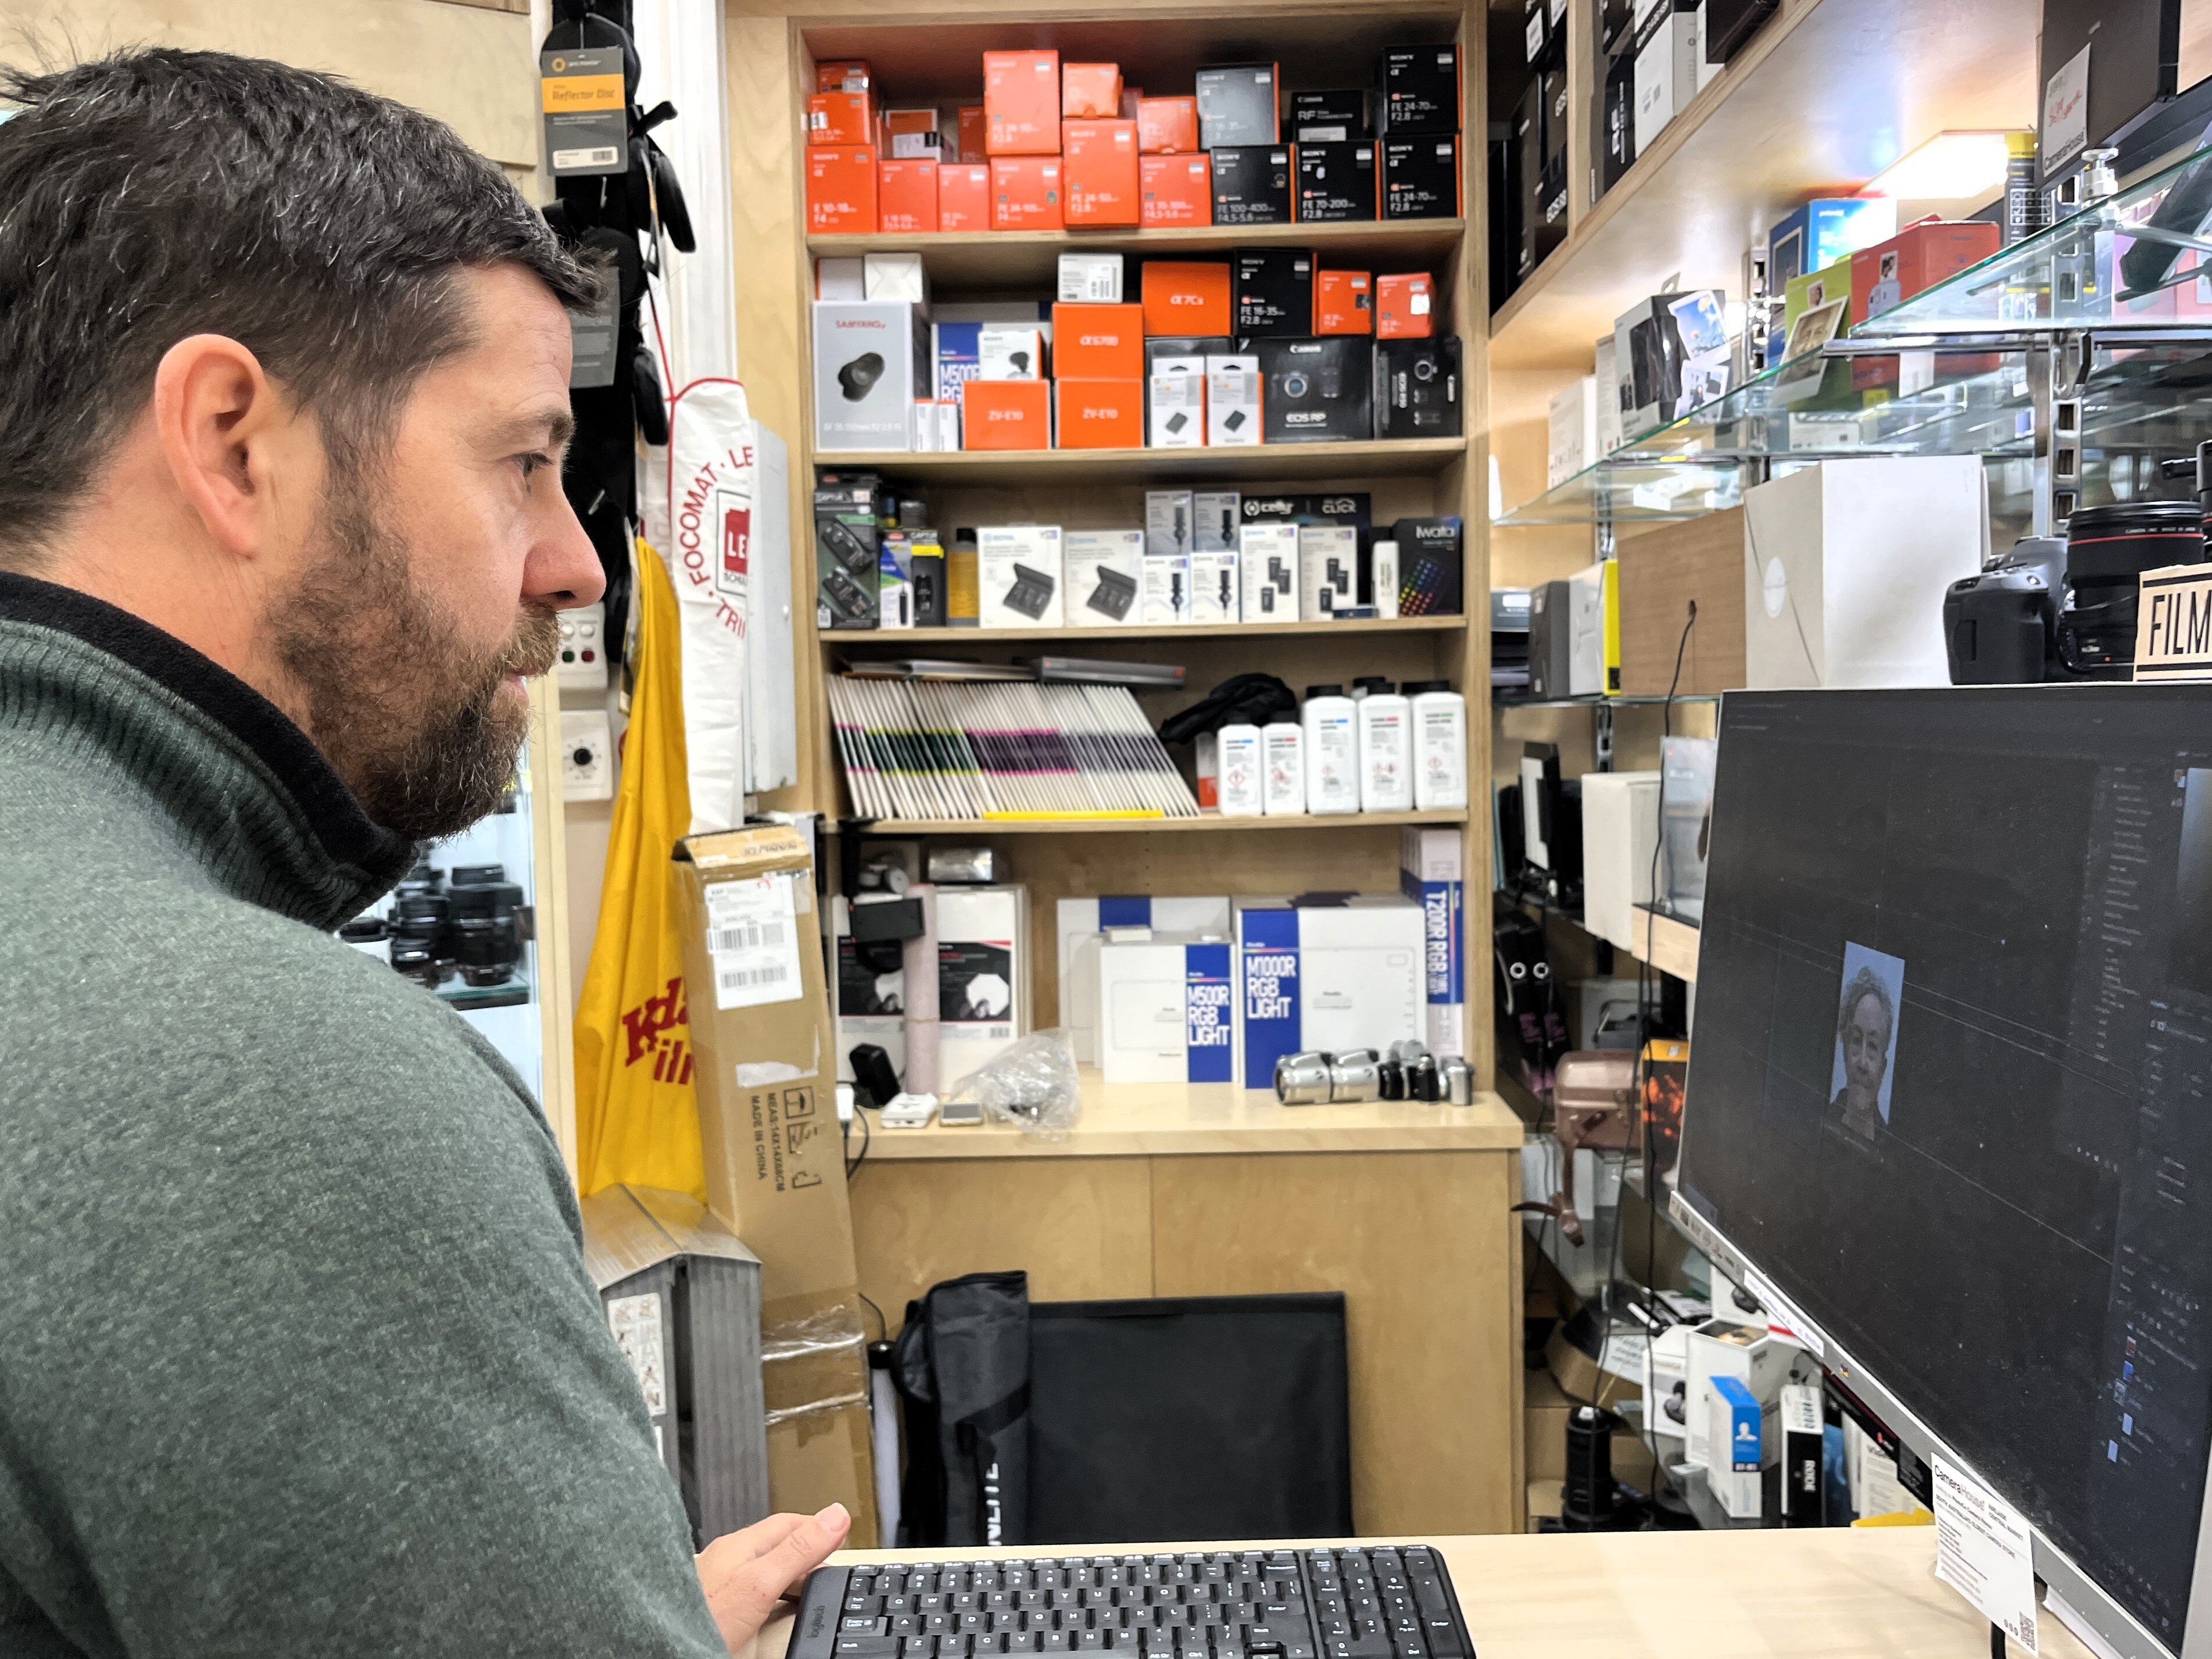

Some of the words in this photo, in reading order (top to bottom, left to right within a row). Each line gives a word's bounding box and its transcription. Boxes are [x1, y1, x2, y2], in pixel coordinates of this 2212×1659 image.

[1241, 316, 1260, 325] F2.8
[941, 385, 962, 403] RG
[989, 410, 1023, 421] ZV-E10
[1082, 408, 1118, 420] ZV-E10
[1286, 412, 1308, 423] EOS
[1310, 412, 1326, 423] RP
[679, 462, 718, 586] FOCOMAT
[2149, 589, 2212, 656] FILM
[1426, 889, 1447, 939] T200R
[1246, 955, 1296, 978] M1000R
[1427, 941, 1448, 973] RGB
[1187, 985, 1229, 1006] M500R
[1247, 977, 1279, 998] RGB
[1188, 1006, 1219, 1026] RGB
[1247, 997, 1293, 1020] LIGHT
[1188, 1025, 1230, 1045] LIGHT
[750, 1095, 763, 1128] MADE
[754, 1130, 764, 1142] IN
[756, 1144, 768, 1181] CHINA
